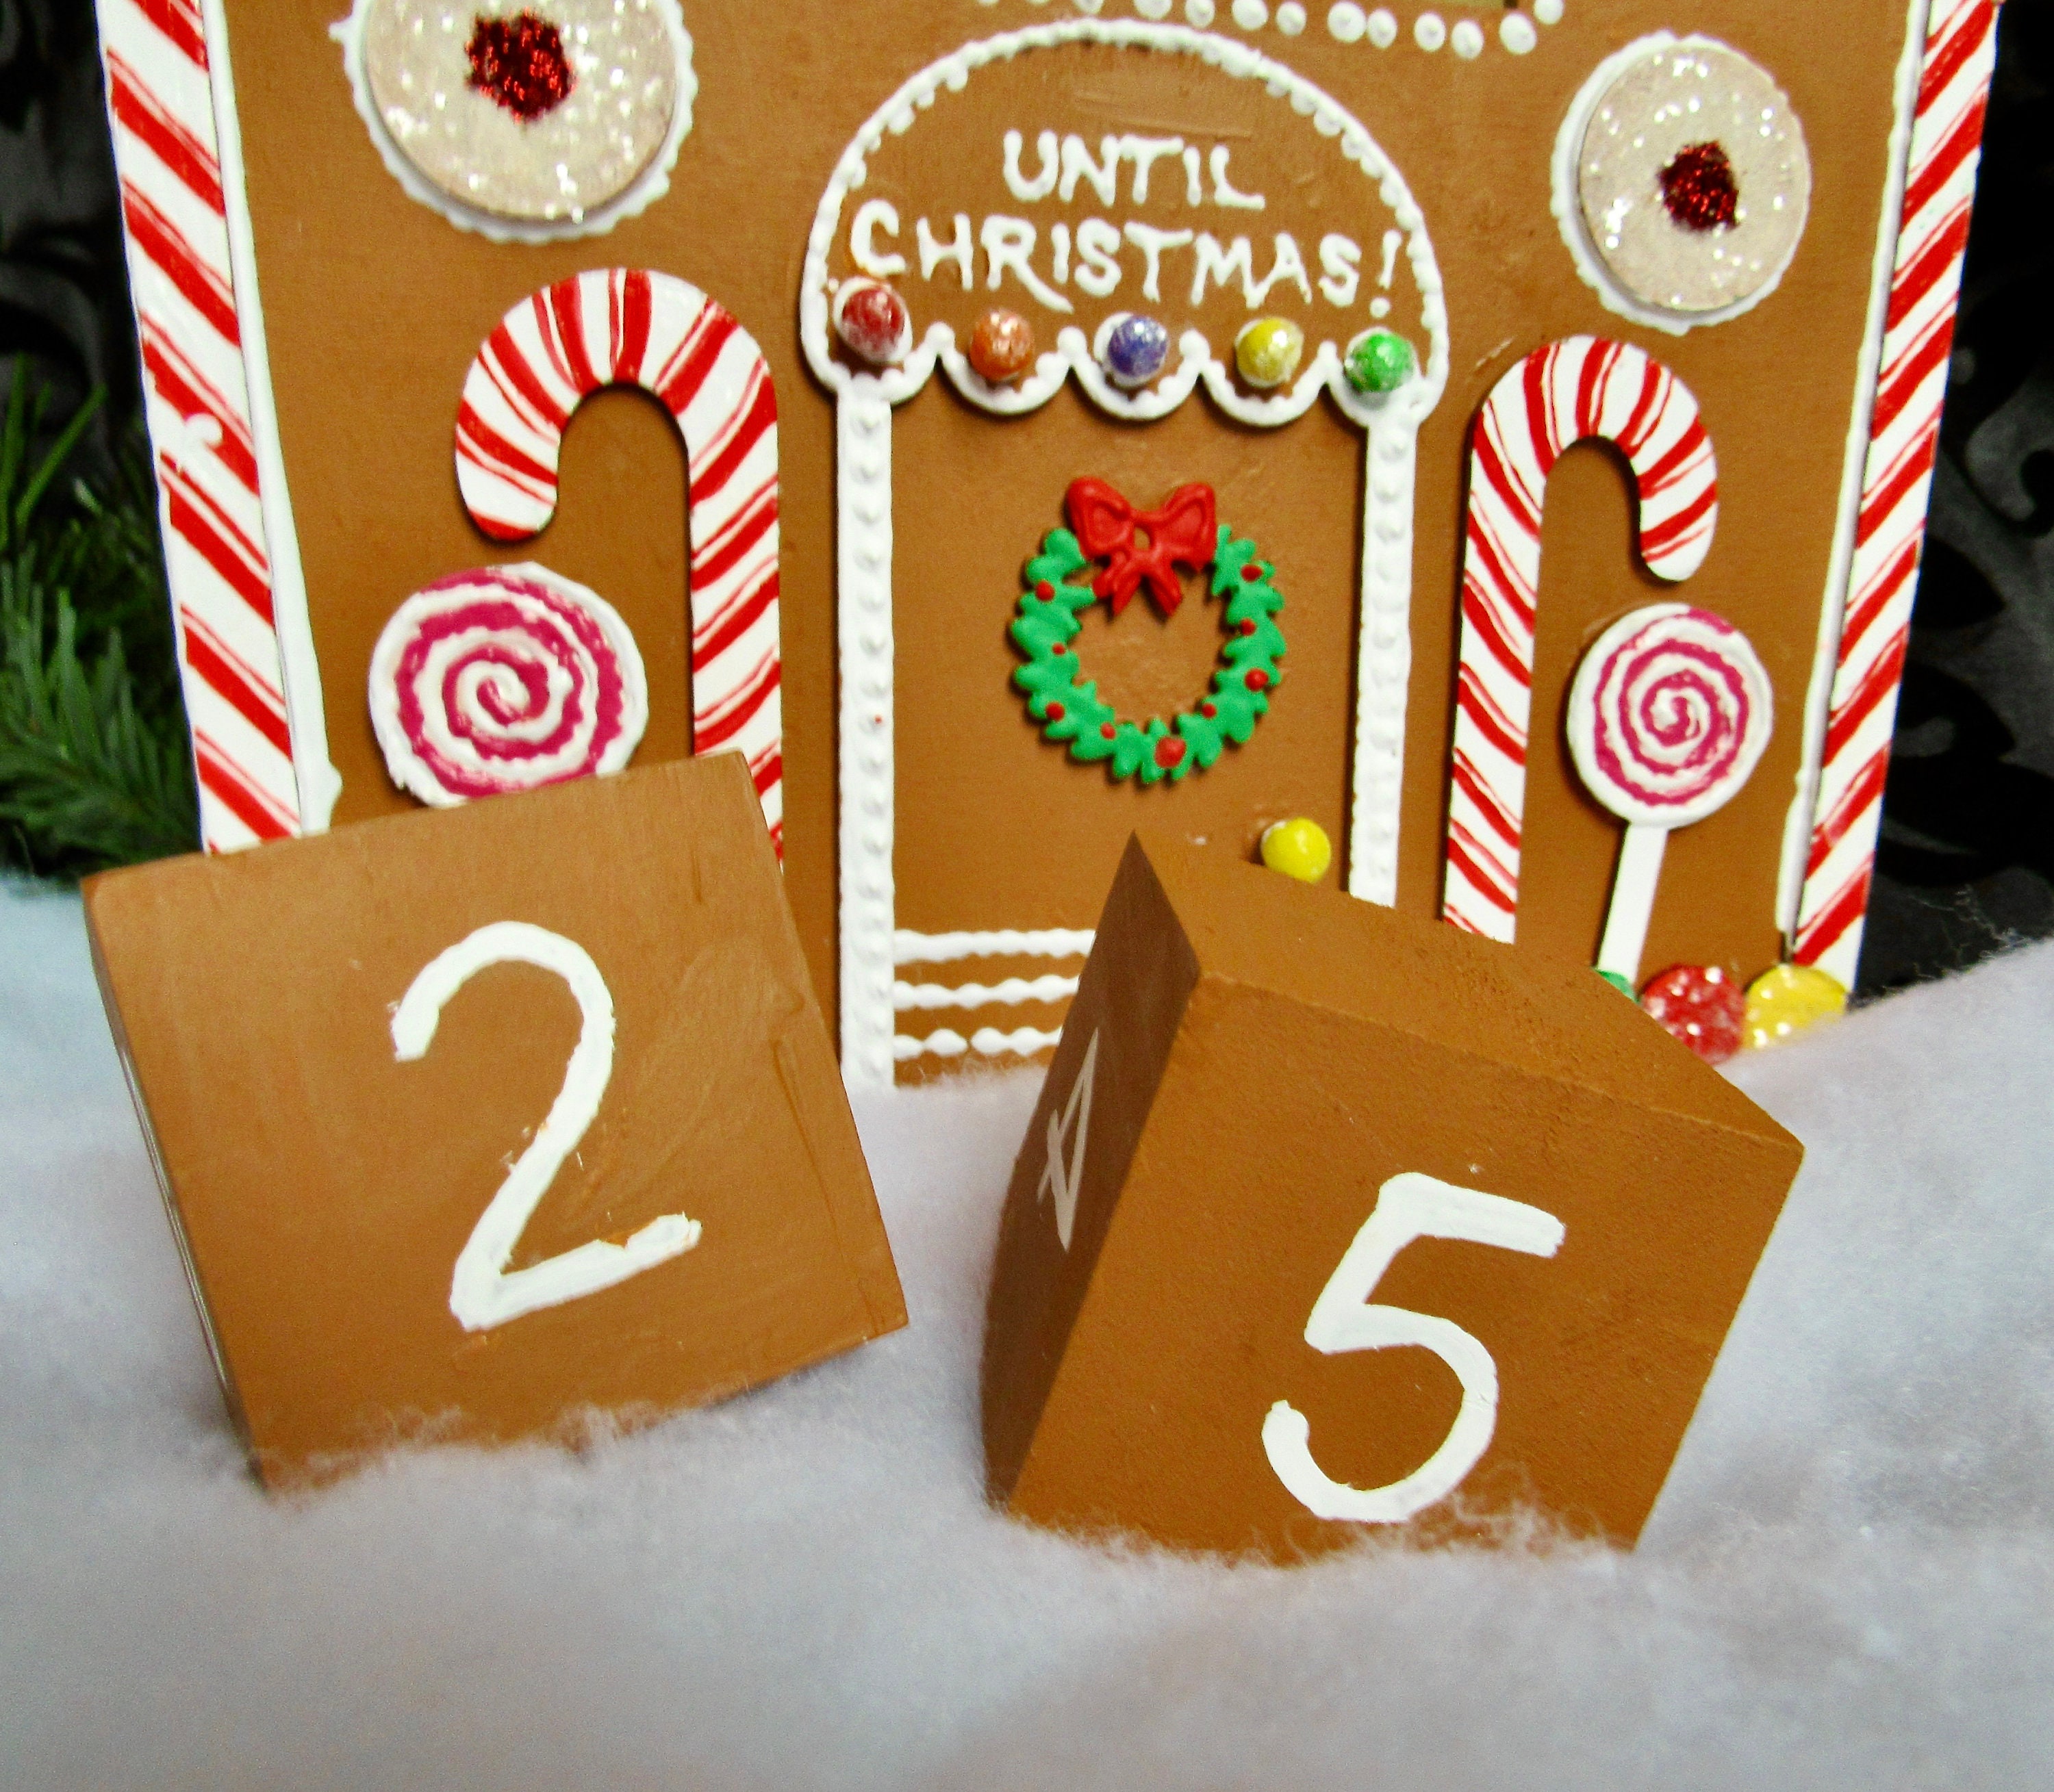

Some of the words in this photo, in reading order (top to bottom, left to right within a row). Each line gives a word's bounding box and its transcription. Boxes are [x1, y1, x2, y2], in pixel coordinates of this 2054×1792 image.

[850, 199, 1402, 318] CHRISTMAS!
[1002, 130, 1265, 207] UNTIL
[390, 920, 703, 1332] 2
[1260, 1171, 1567, 1523] 5
